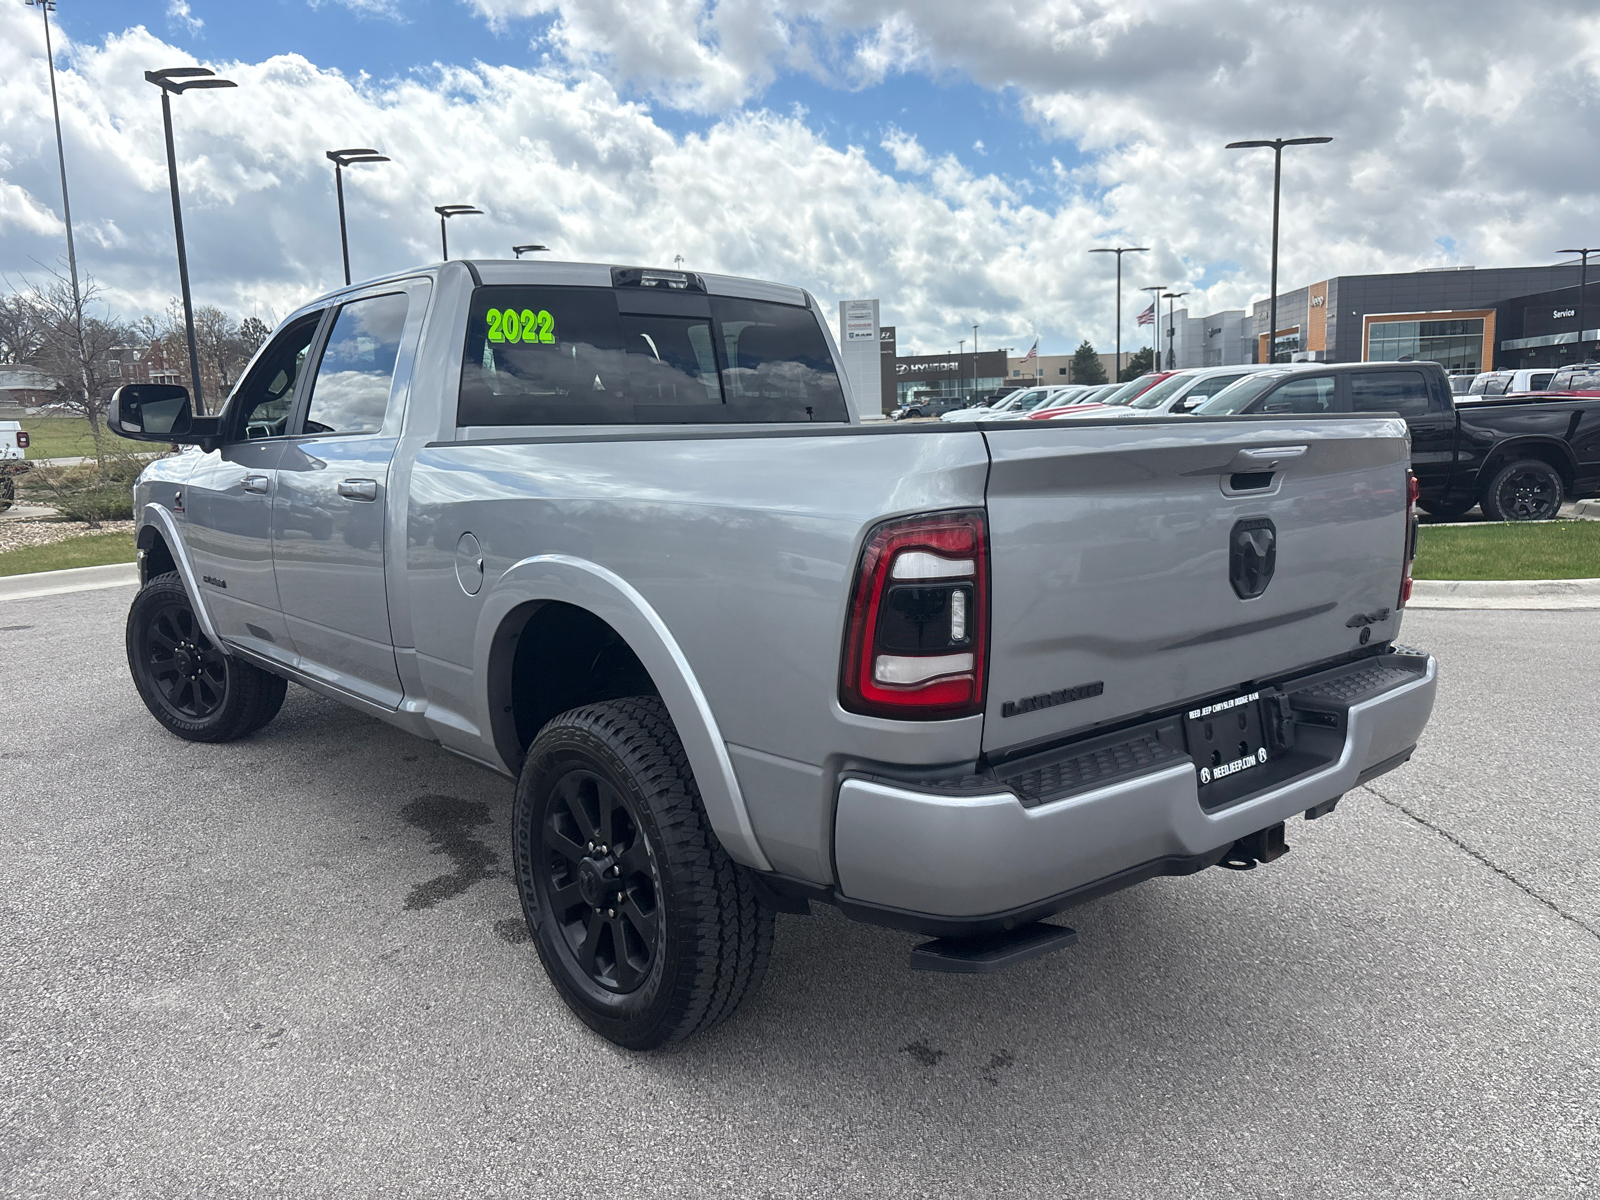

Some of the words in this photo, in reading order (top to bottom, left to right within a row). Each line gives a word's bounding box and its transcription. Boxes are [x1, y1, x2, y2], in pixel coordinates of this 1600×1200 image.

[1311, 295, 1324, 307] Jeep
[1553, 308, 1575, 319] Service
[486, 308, 556, 345] 2022
[910, 362, 959, 374] HYUNDAI
[1188, 709, 1201, 720] REED
[1201, 706, 1212, 716] JEEP
[1212, 699, 1234, 713] CHRYSLER
[1235, 695, 1248, 706] DODGE
[1249, 692, 1260, 702] RAM
[1213, 755, 1256, 779] REEDJEEP.COM
